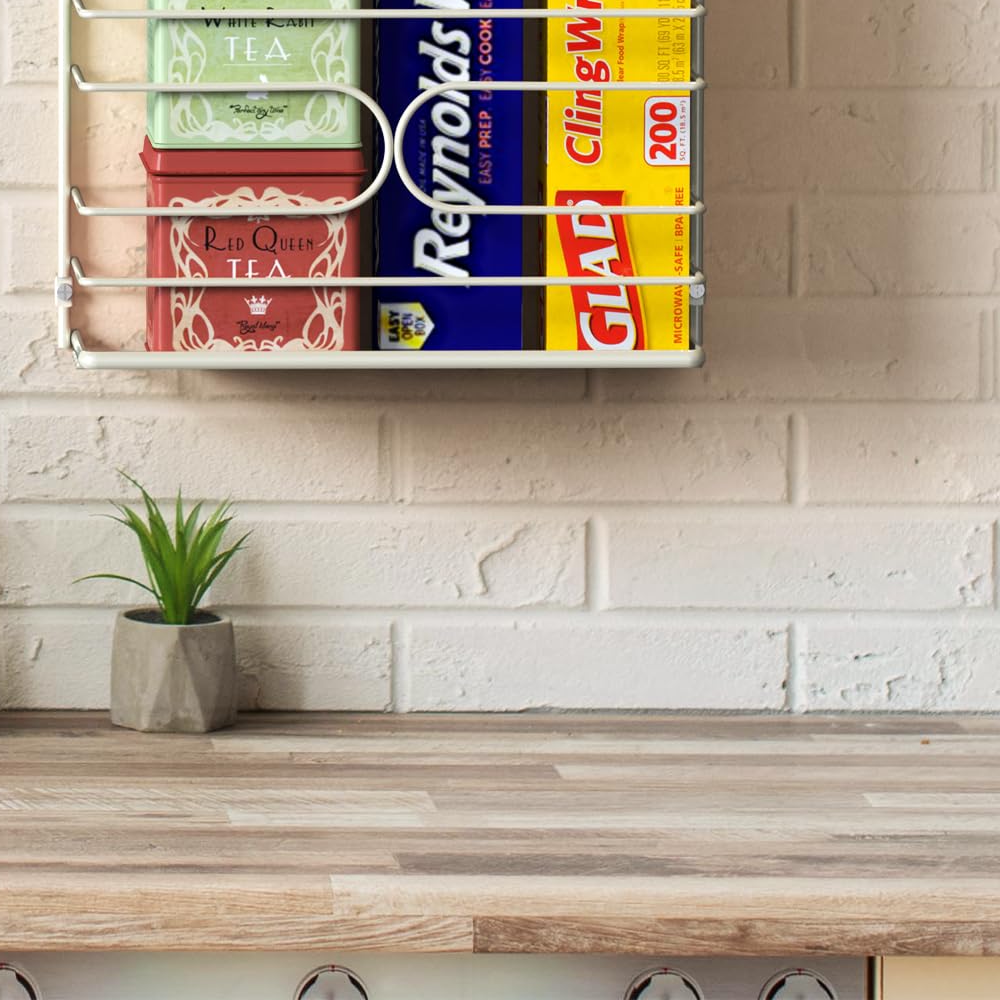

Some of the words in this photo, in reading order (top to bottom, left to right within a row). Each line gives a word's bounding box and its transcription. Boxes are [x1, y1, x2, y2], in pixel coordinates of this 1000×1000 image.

[617, 23, 626, 44] Wrap
[224, 36, 292, 61] TEA
[617, 45, 625, 65] Food
[617, 67, 625, 82] lear
[564, 56, 611, 165] Cling
[648, 101, 678, 160] 200
[413, 20, 487, 288] Reynolds
[478, 152, 493, 185] EASY
[674, 187, 685, 206] REE
[204, 225, 245, 251] RED
[252, 225, 314, 255] QUEEN
[226, 258, 292, 279] TEA
[388, 310, 400, 342] EASY
[401, 313, 413, 340] OPEN
[414, 315, 425, 336] BOX
